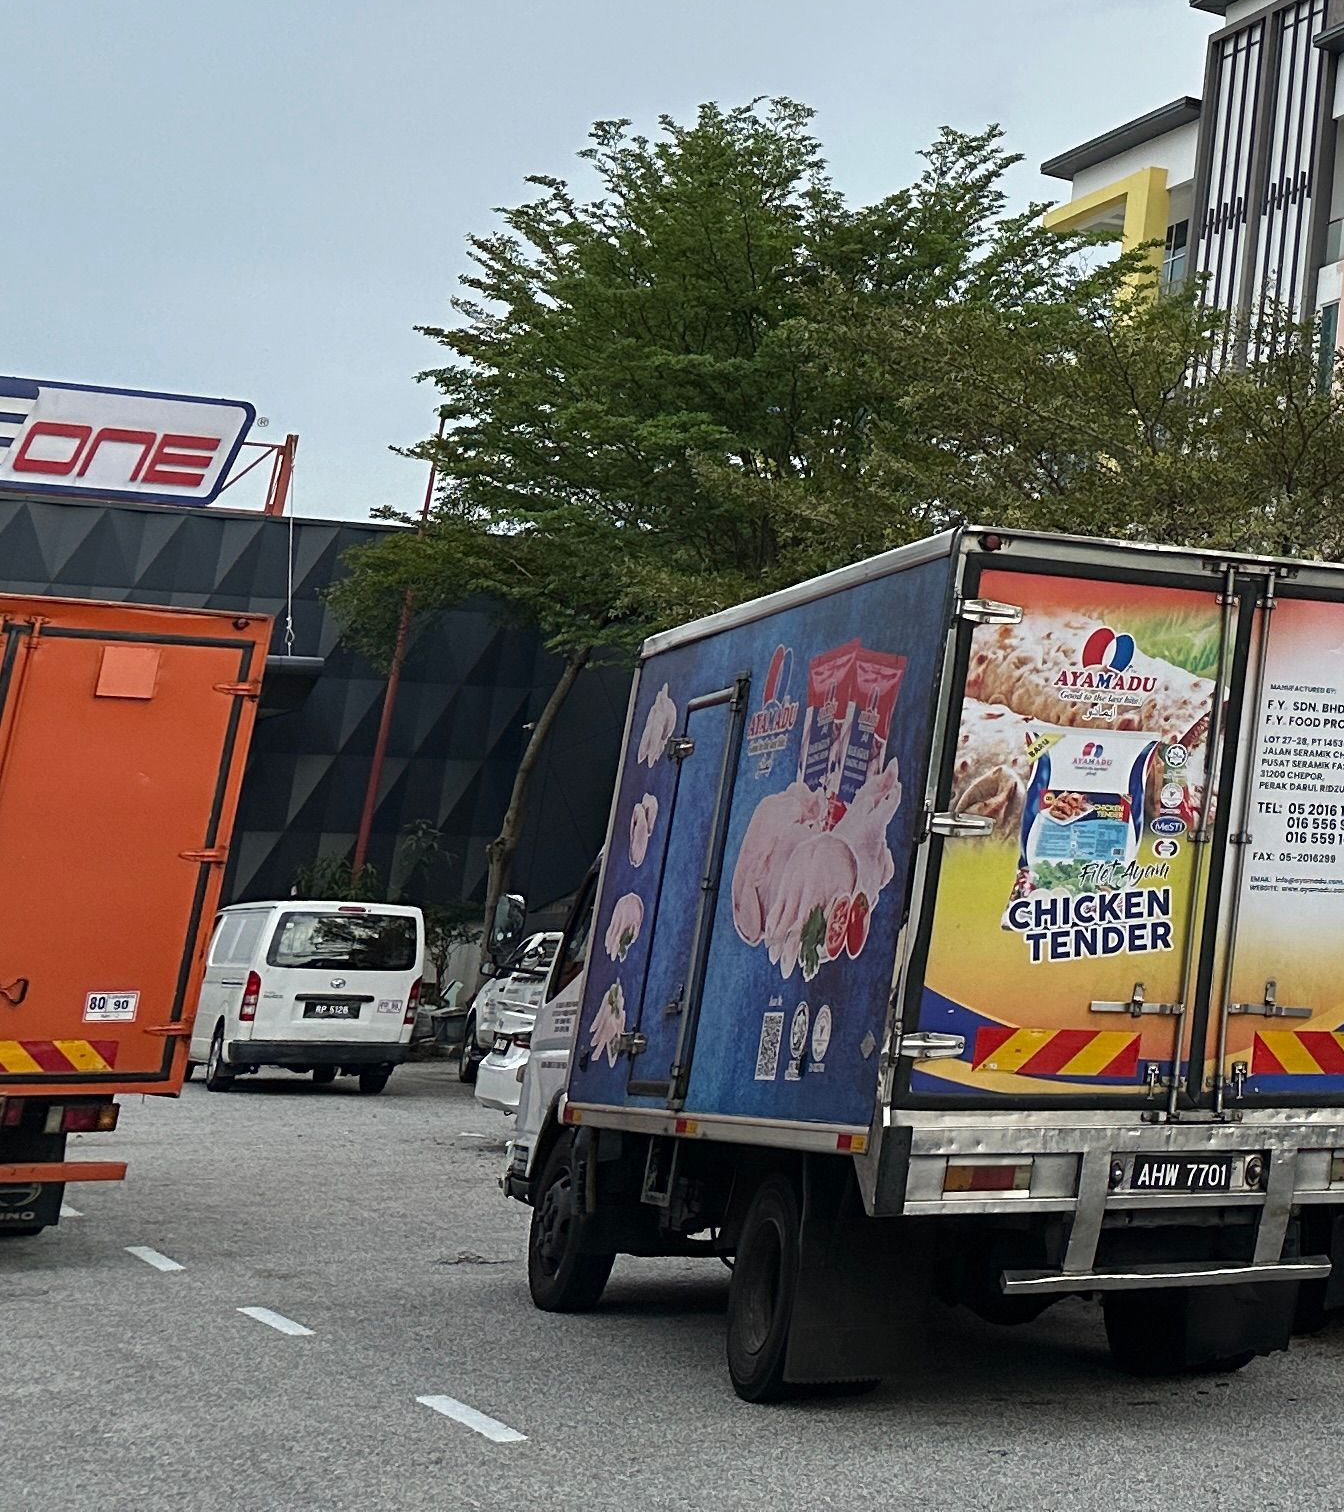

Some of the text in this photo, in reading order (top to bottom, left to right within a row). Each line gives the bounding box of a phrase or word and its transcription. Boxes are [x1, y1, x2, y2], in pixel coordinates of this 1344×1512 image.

[1053, 669, 1158, 693] AYAMADU
[1293, 701, 1319, 713] SDN.
[1289, 715, 1321, 728] FOOD
[1028, 738, 1050, 758] BARU
[1263, 735, 1281, 744] LOT
[1311, 738, 1322, 747] PT
[1263, 746, 1292, 756] JALAN
[1292, 748, 1332, 758] SERAMIK
[1261, 758, 1290, 767] PUSAT
[1291, 759, 1330, 769] SERAMIK
[1260, 769, 1286, 779] 31200
[1259, 781, 1288, 790] PERAK
[1289, 782, 1318, 792] DARUL
[1257, 801, 1283, 815] TEL:
[1288, 802, 1305, 815] 05
[1308, 803, 1338, 816] 2016
[1287, 816, 1309, 830] 016
[1312, 818, 1337, 831] 556
[1285, 831, 1307, 844] 016
[1310, 832, 1335, 845] 559
[1252, 851, 1275, 862] FAX:
[1008, 888, 1170, 930] CHICKEN
[1026, 921, 1172, 962] TENDER
[89, 996, 129, 1011] 80 90
[1137, 1163, 1227, 1187] AHW 7701
